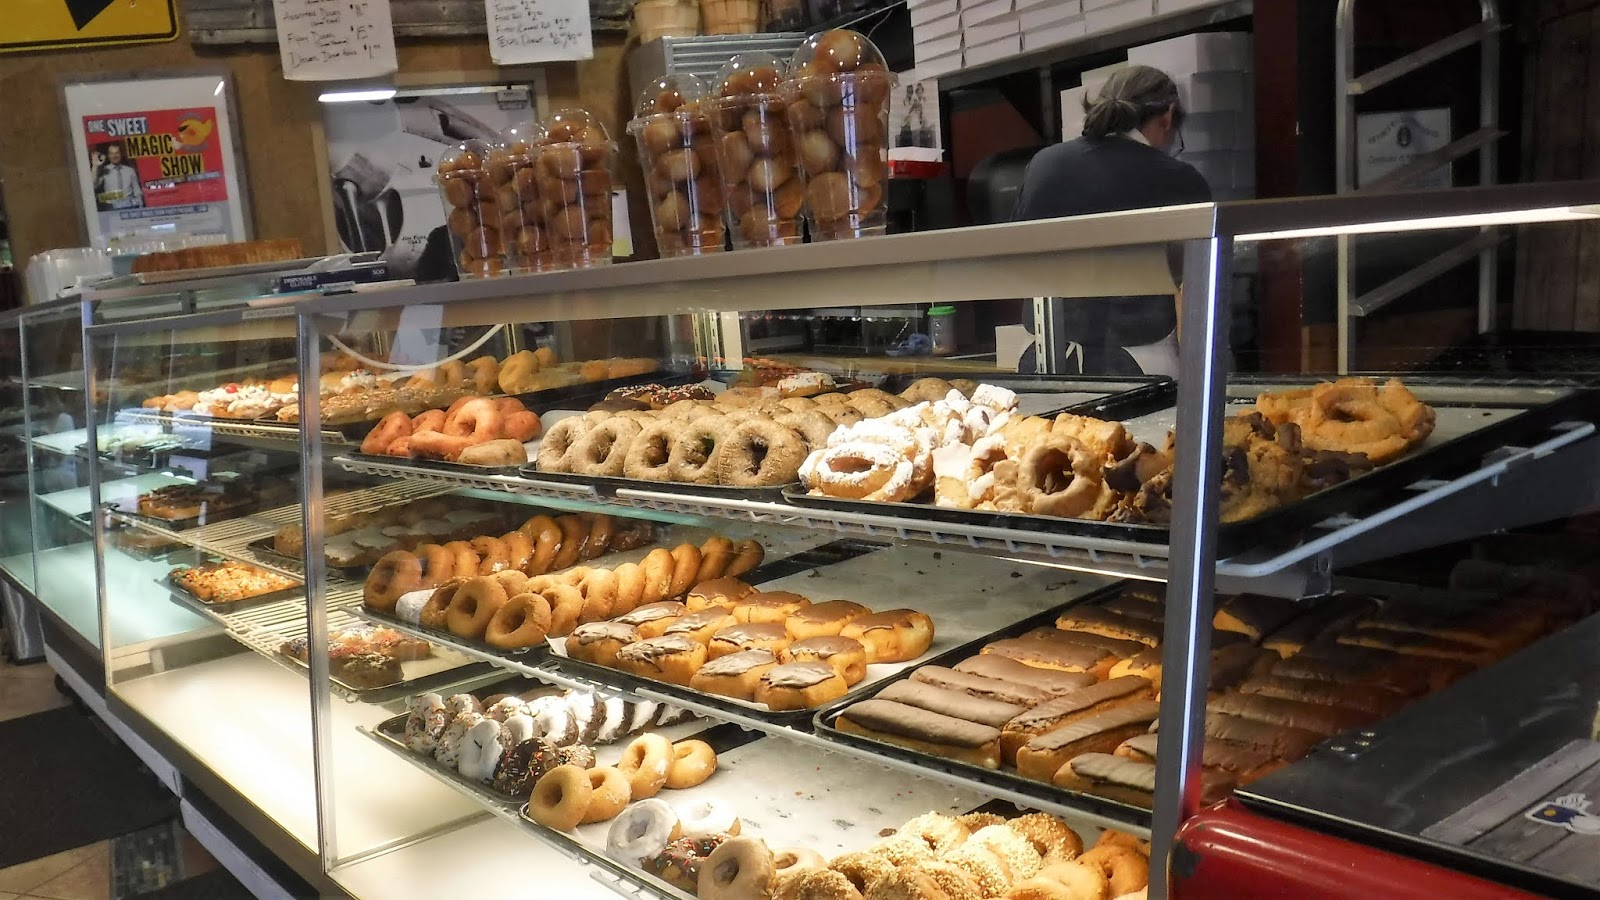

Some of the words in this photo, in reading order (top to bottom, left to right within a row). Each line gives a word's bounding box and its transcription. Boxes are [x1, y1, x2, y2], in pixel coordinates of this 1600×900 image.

[87, 119, 106, 133] ONE
[106, 116, 147, 137] SWEET
[126, 134, 174, 157] MAGIC
[161, 154, 202, 177] SHOW
